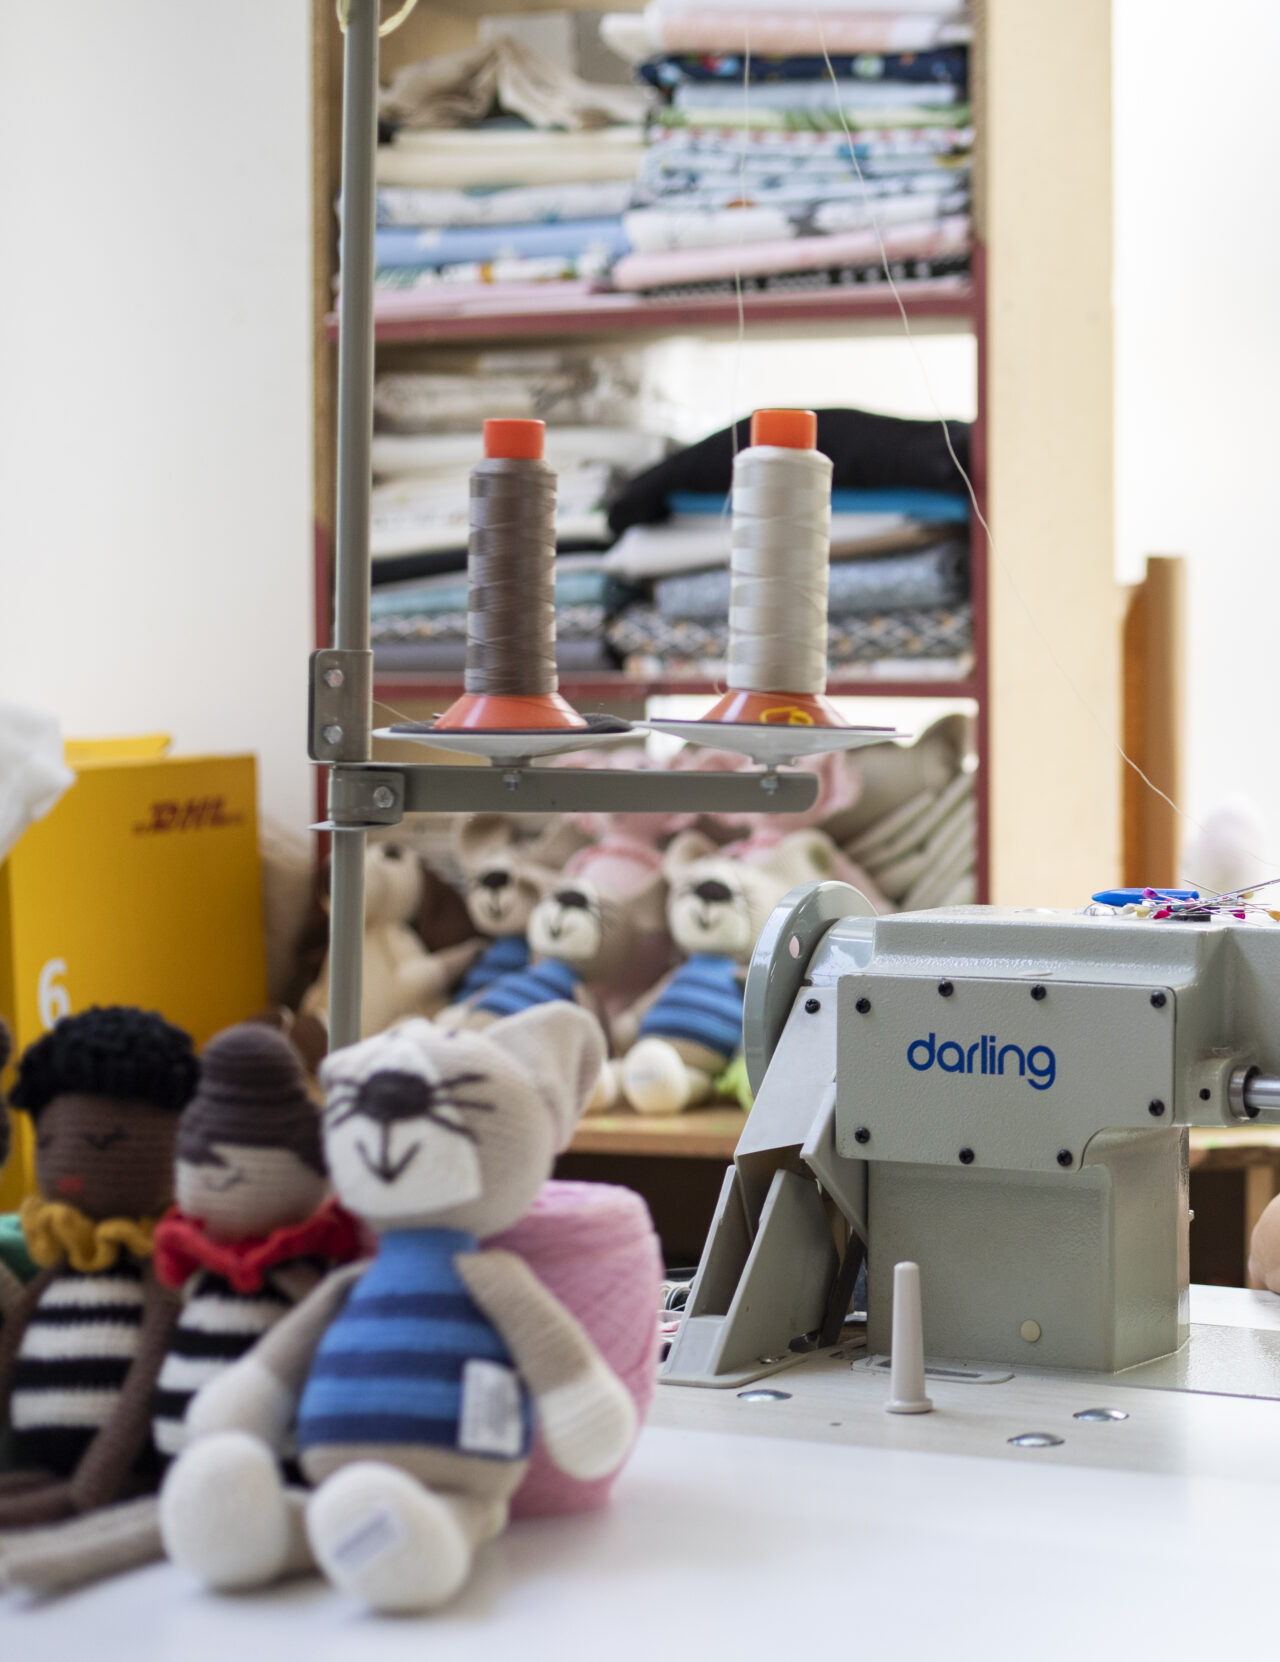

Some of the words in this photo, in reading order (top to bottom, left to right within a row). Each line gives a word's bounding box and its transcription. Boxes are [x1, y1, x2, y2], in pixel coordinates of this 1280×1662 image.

[146, 795, 230, 833] DHL
[37, 957, 71, 1030] 6
[907, 1032, 1056, 1091] darling
